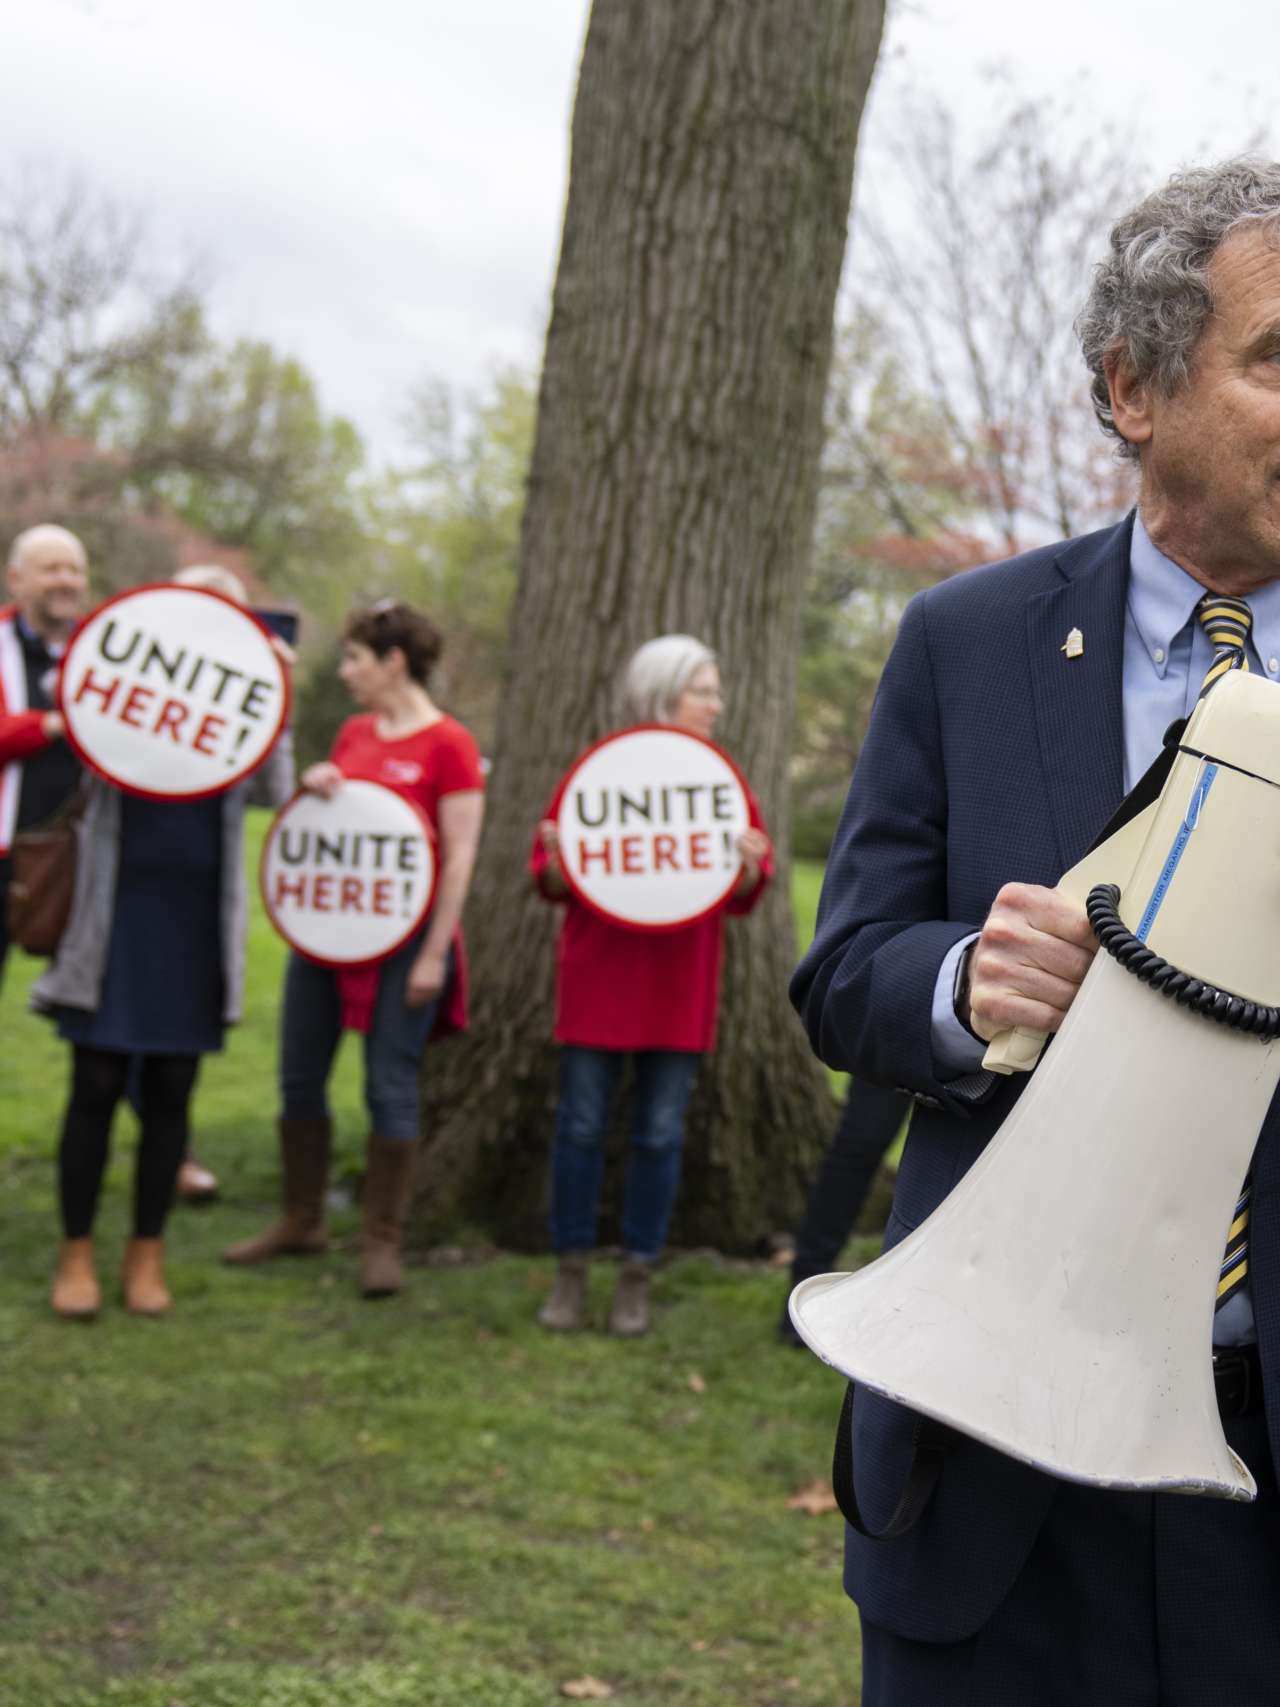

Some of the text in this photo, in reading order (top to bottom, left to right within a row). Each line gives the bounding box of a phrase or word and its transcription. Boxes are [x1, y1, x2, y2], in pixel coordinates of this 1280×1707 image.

[98, 619, 275, 721] UNITE
[73, 669, 251, 766] HERE!
[576, 783, 734, 828] UNITE
[278, 830, 421, 871] UNITE
[578, 831, 732, 875] HERE!
[276, 873, 414, 919] HERE!
